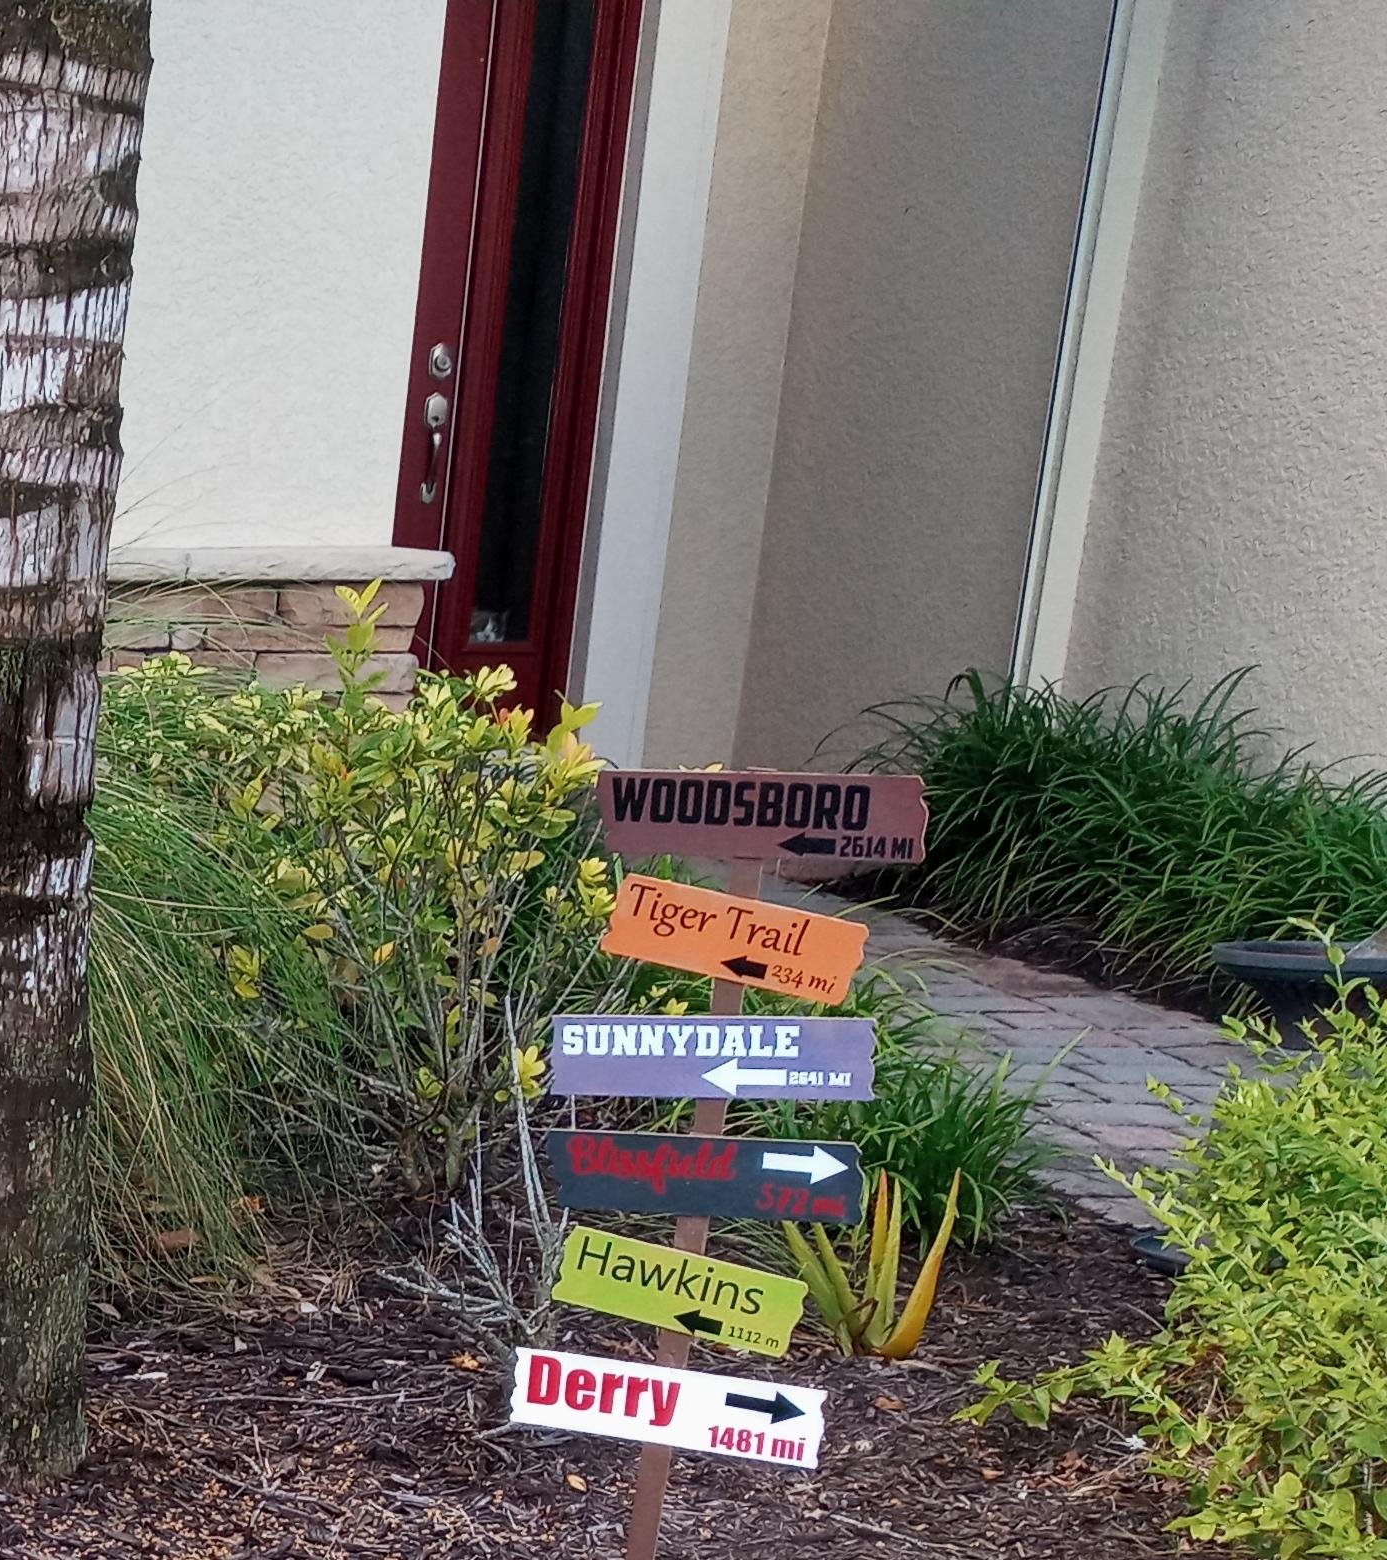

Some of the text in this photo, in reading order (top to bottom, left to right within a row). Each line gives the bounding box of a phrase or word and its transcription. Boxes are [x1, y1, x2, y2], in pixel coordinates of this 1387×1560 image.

[612, 777, 871, 831] WOODSBORO
[840, 835, 914, 859] 2614 MI
[630, 884, 811, 956] Tiger Trail
[772, 965, 838, 995] 234 mi
[562, 1025, 801, 1057] SUNNYDALE
[788, 1071, 852, 1086] 2641 MI
[566, 1134, 740, 1195] Blissfield
[756, 1183, 812, 1215] 572
[576, 1235, 765, 1315] Hawkins
[728, 1326, 762, 1345] 1112
[527, 1355, 681, 1427] Derry
[708, 1425, 807, 1462] 1481 mi
